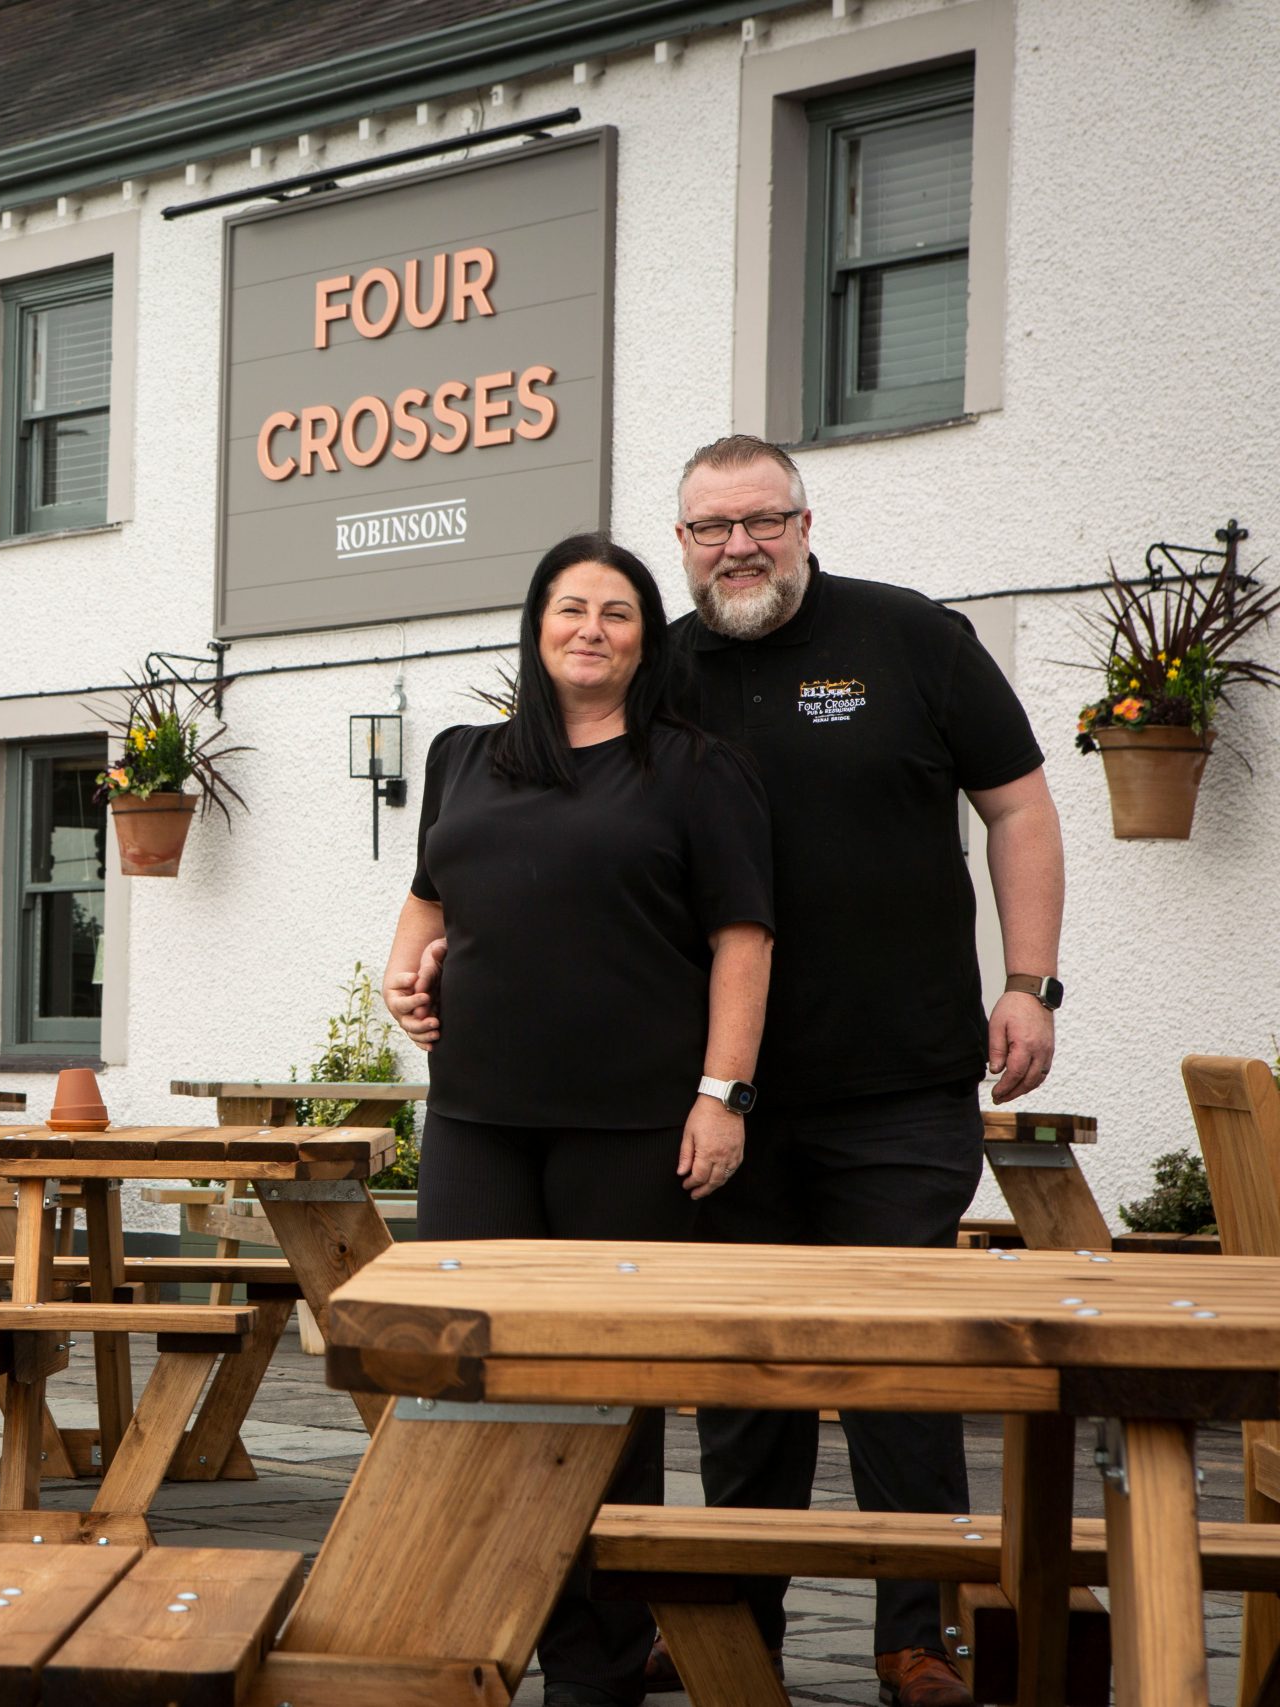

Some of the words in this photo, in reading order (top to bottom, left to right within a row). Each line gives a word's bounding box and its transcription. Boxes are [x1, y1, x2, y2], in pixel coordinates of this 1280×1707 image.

[314, 247, 497, 348] FOUR
[257, 365, 558, 481] CROSSES
[335, 506, 468, 552] ROBINSONS
